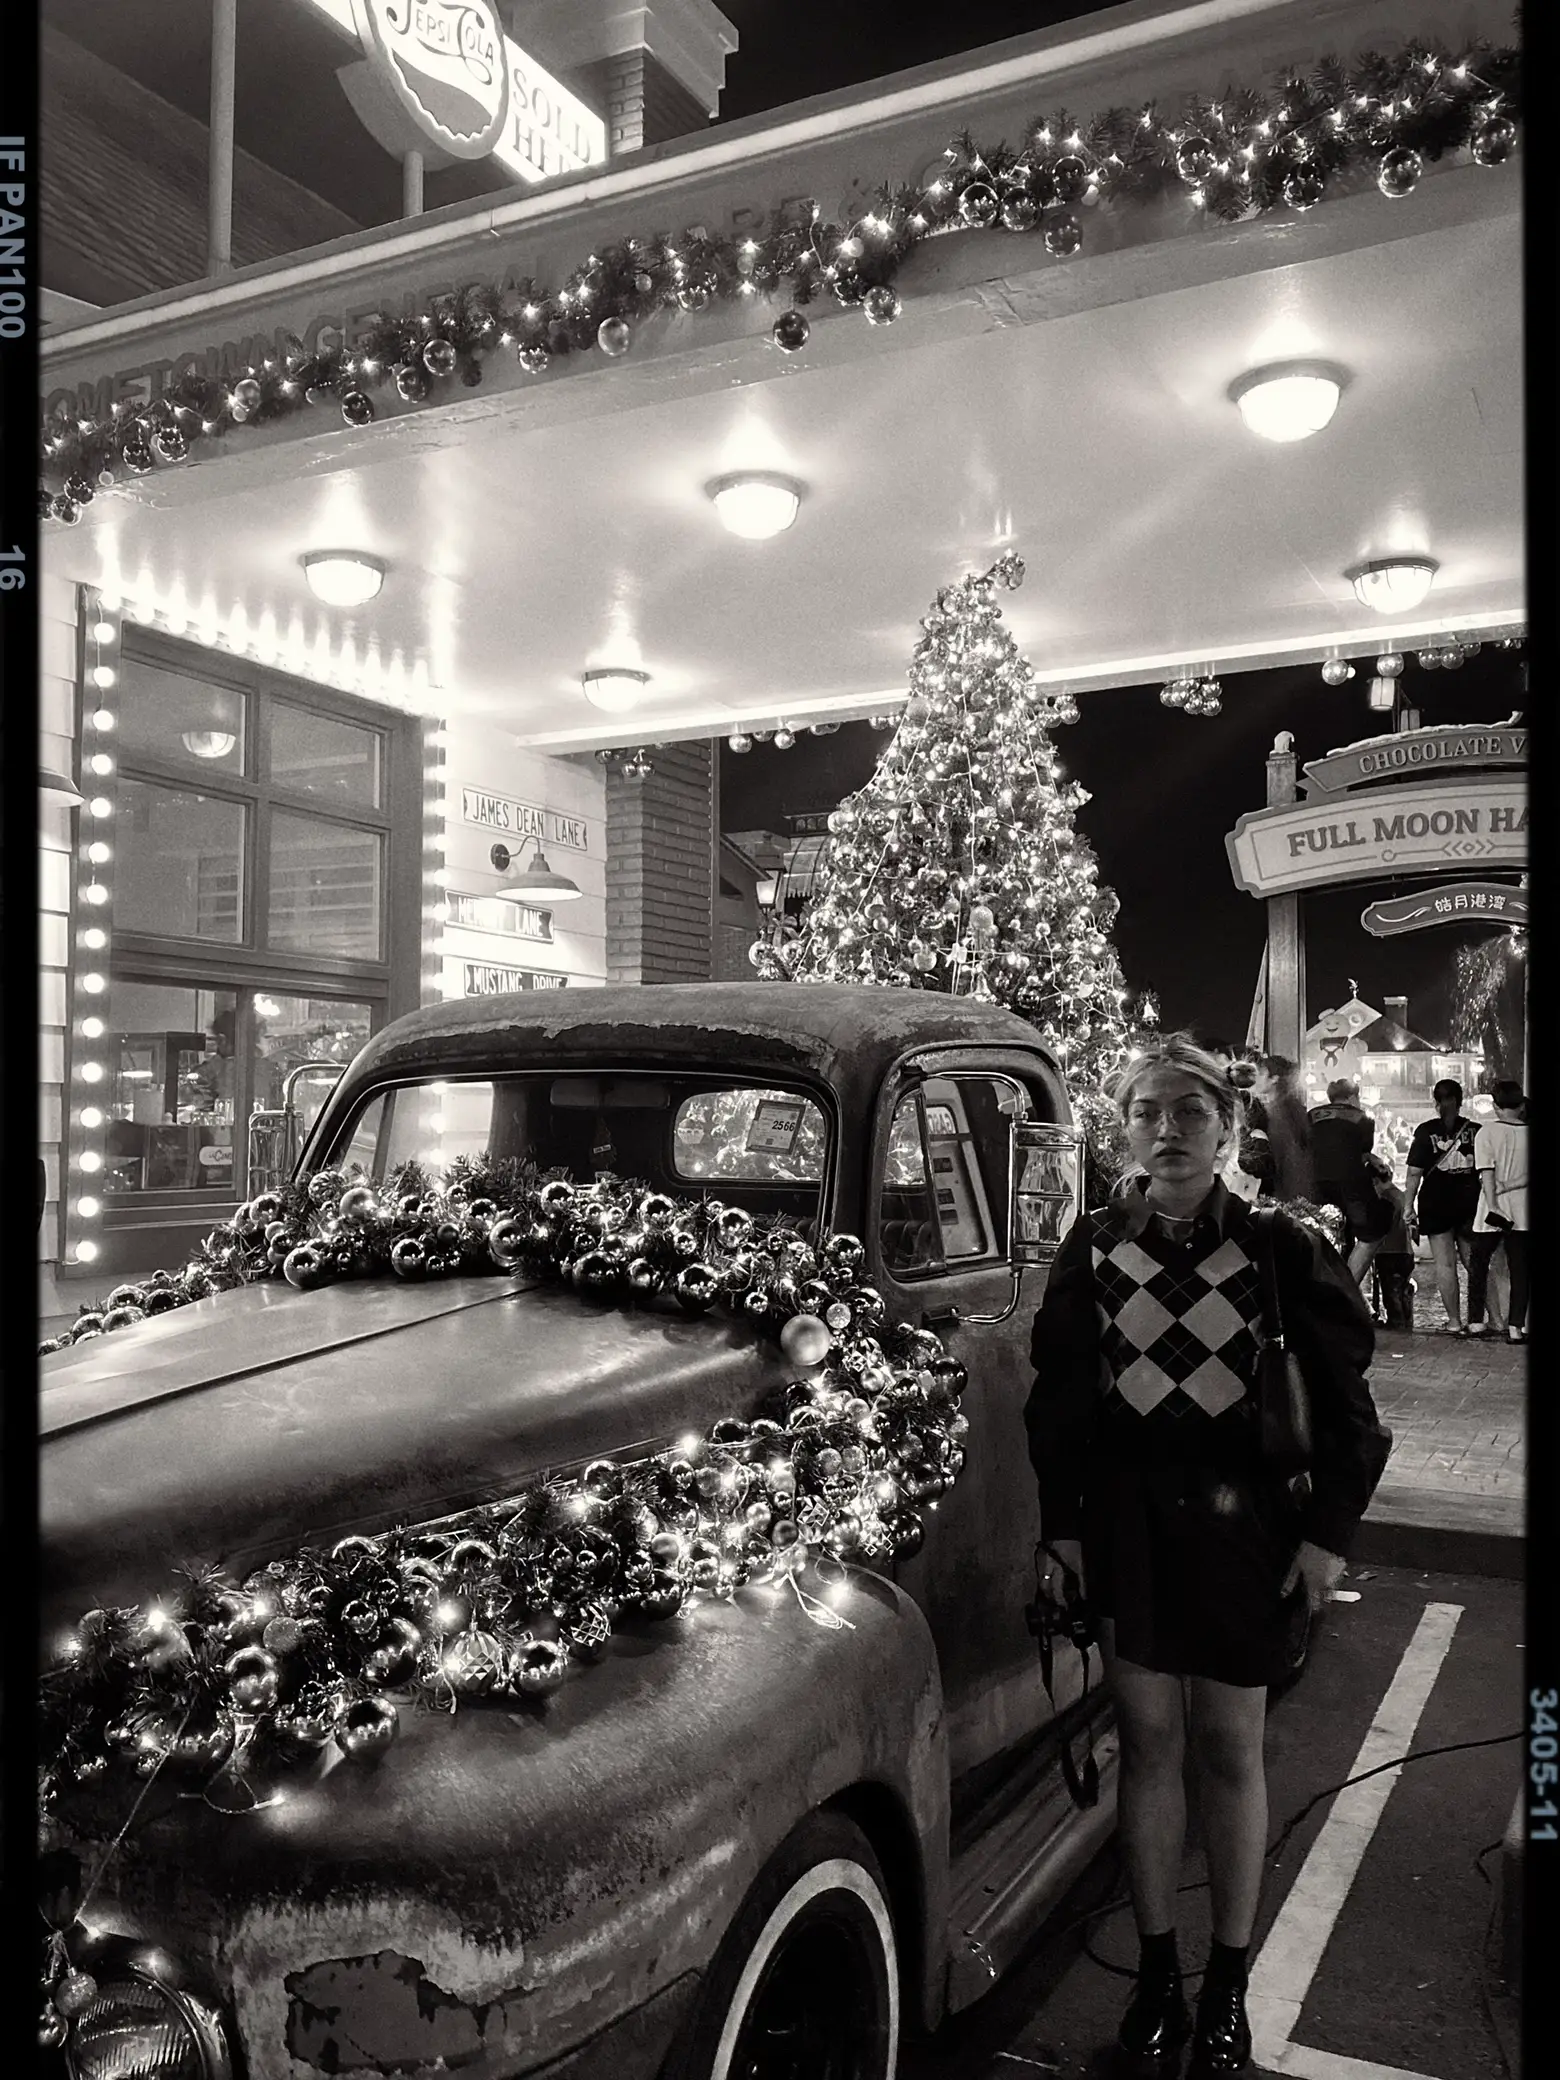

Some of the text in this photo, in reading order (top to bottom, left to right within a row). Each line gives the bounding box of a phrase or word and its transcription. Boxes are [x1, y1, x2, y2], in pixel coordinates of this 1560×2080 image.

[513, 68, 591, 164] SOLD
[1359, 736, 1503, 774] CHOCOLATE
[473, 794, 581, 847] JAMES DEAN LANE
[1287, 819, 1366, 858] FULL
[1372, 807, 1480, 843] MOON
[1434, 893, 1507, 913] 皓月港湾
[515, 905, 544, 938] LANE
[473, 966, 523, 996] MUSTANG
[771, 1120, 796, 1132] 2566
